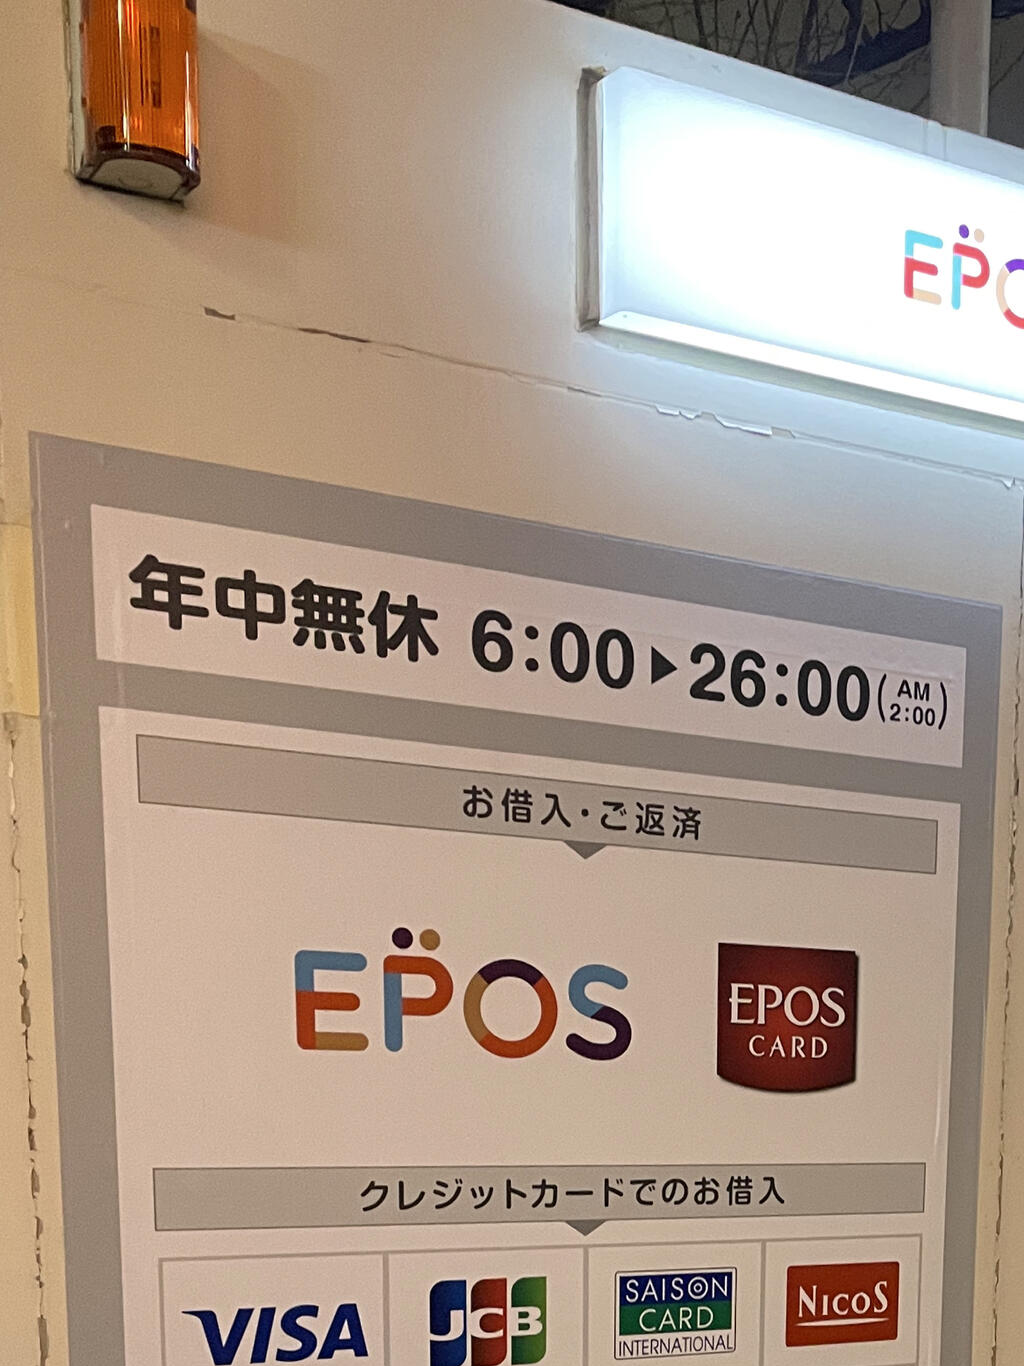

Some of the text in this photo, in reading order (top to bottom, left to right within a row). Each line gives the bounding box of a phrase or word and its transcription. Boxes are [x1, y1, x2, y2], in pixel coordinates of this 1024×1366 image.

[129, 555, 869, 722] 年中無休 6:00 26:00
[462, 785, 702, 840] お借入・ご返済
[294, 927, 632, 1061] EPOS
[728, 982, 846, 1029] EPOS
[748, 1034, 828, 1060] CARD
[360, 1176, 786, 1214] クレジットカードでのお借入
[625, 1275, 728, 1304] SAISON
[182, 1303, 368, 1366] VISA
[639, 1306, 714, 1332] CARD
[618, 1333, 733, 1357] INTERNATIONAL
